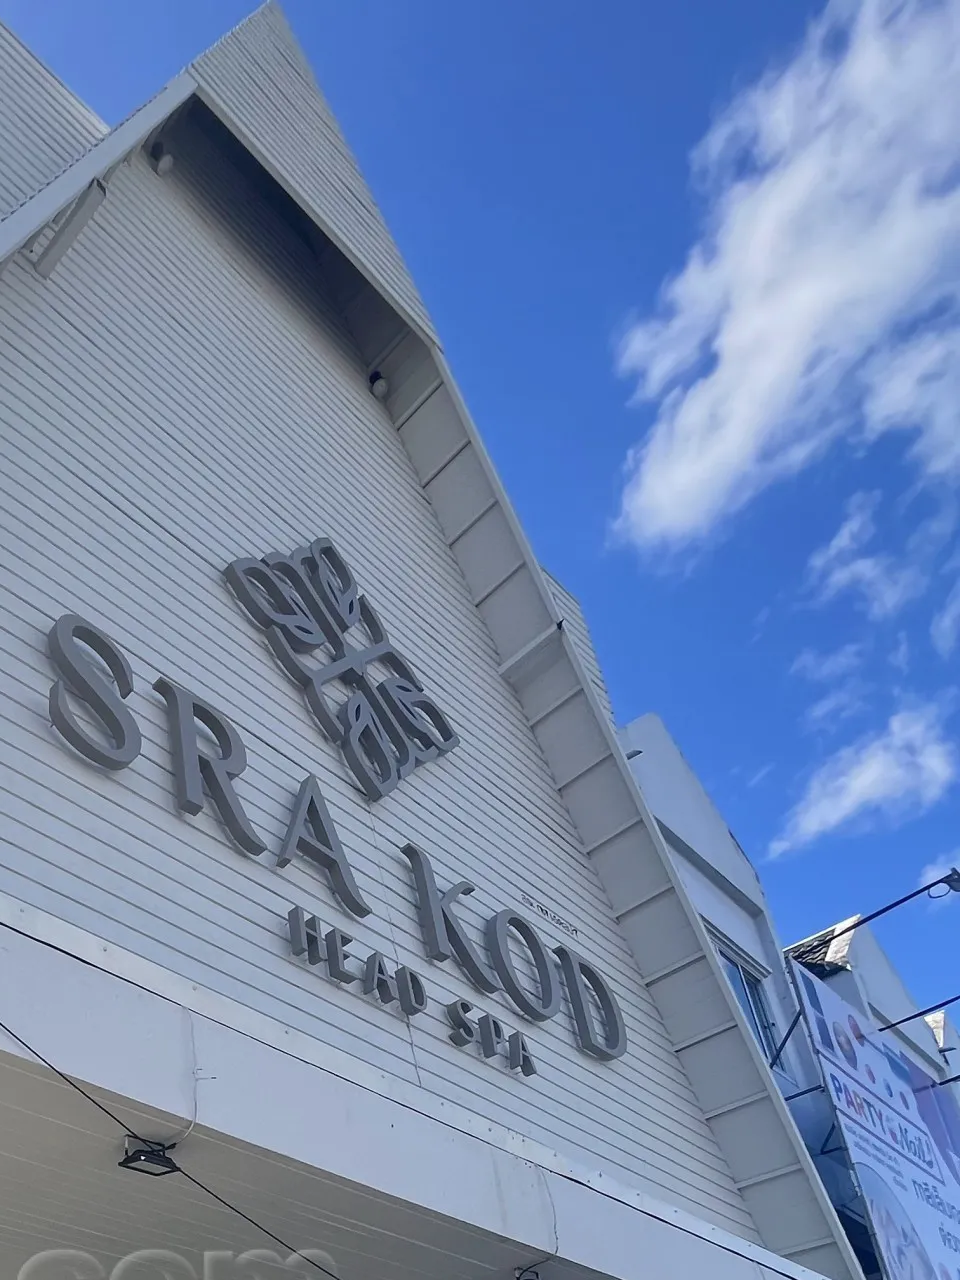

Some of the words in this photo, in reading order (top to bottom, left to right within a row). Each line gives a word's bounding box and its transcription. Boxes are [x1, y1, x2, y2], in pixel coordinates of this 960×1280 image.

[48, 613, 373, 918] SRA
[400, 843, 627, 1062] KOD
[287, 904, 428, 1016] HEAD
[447, 1000, 538, 1077] SPA
[830, 1073, 886, 1135] PARTY
